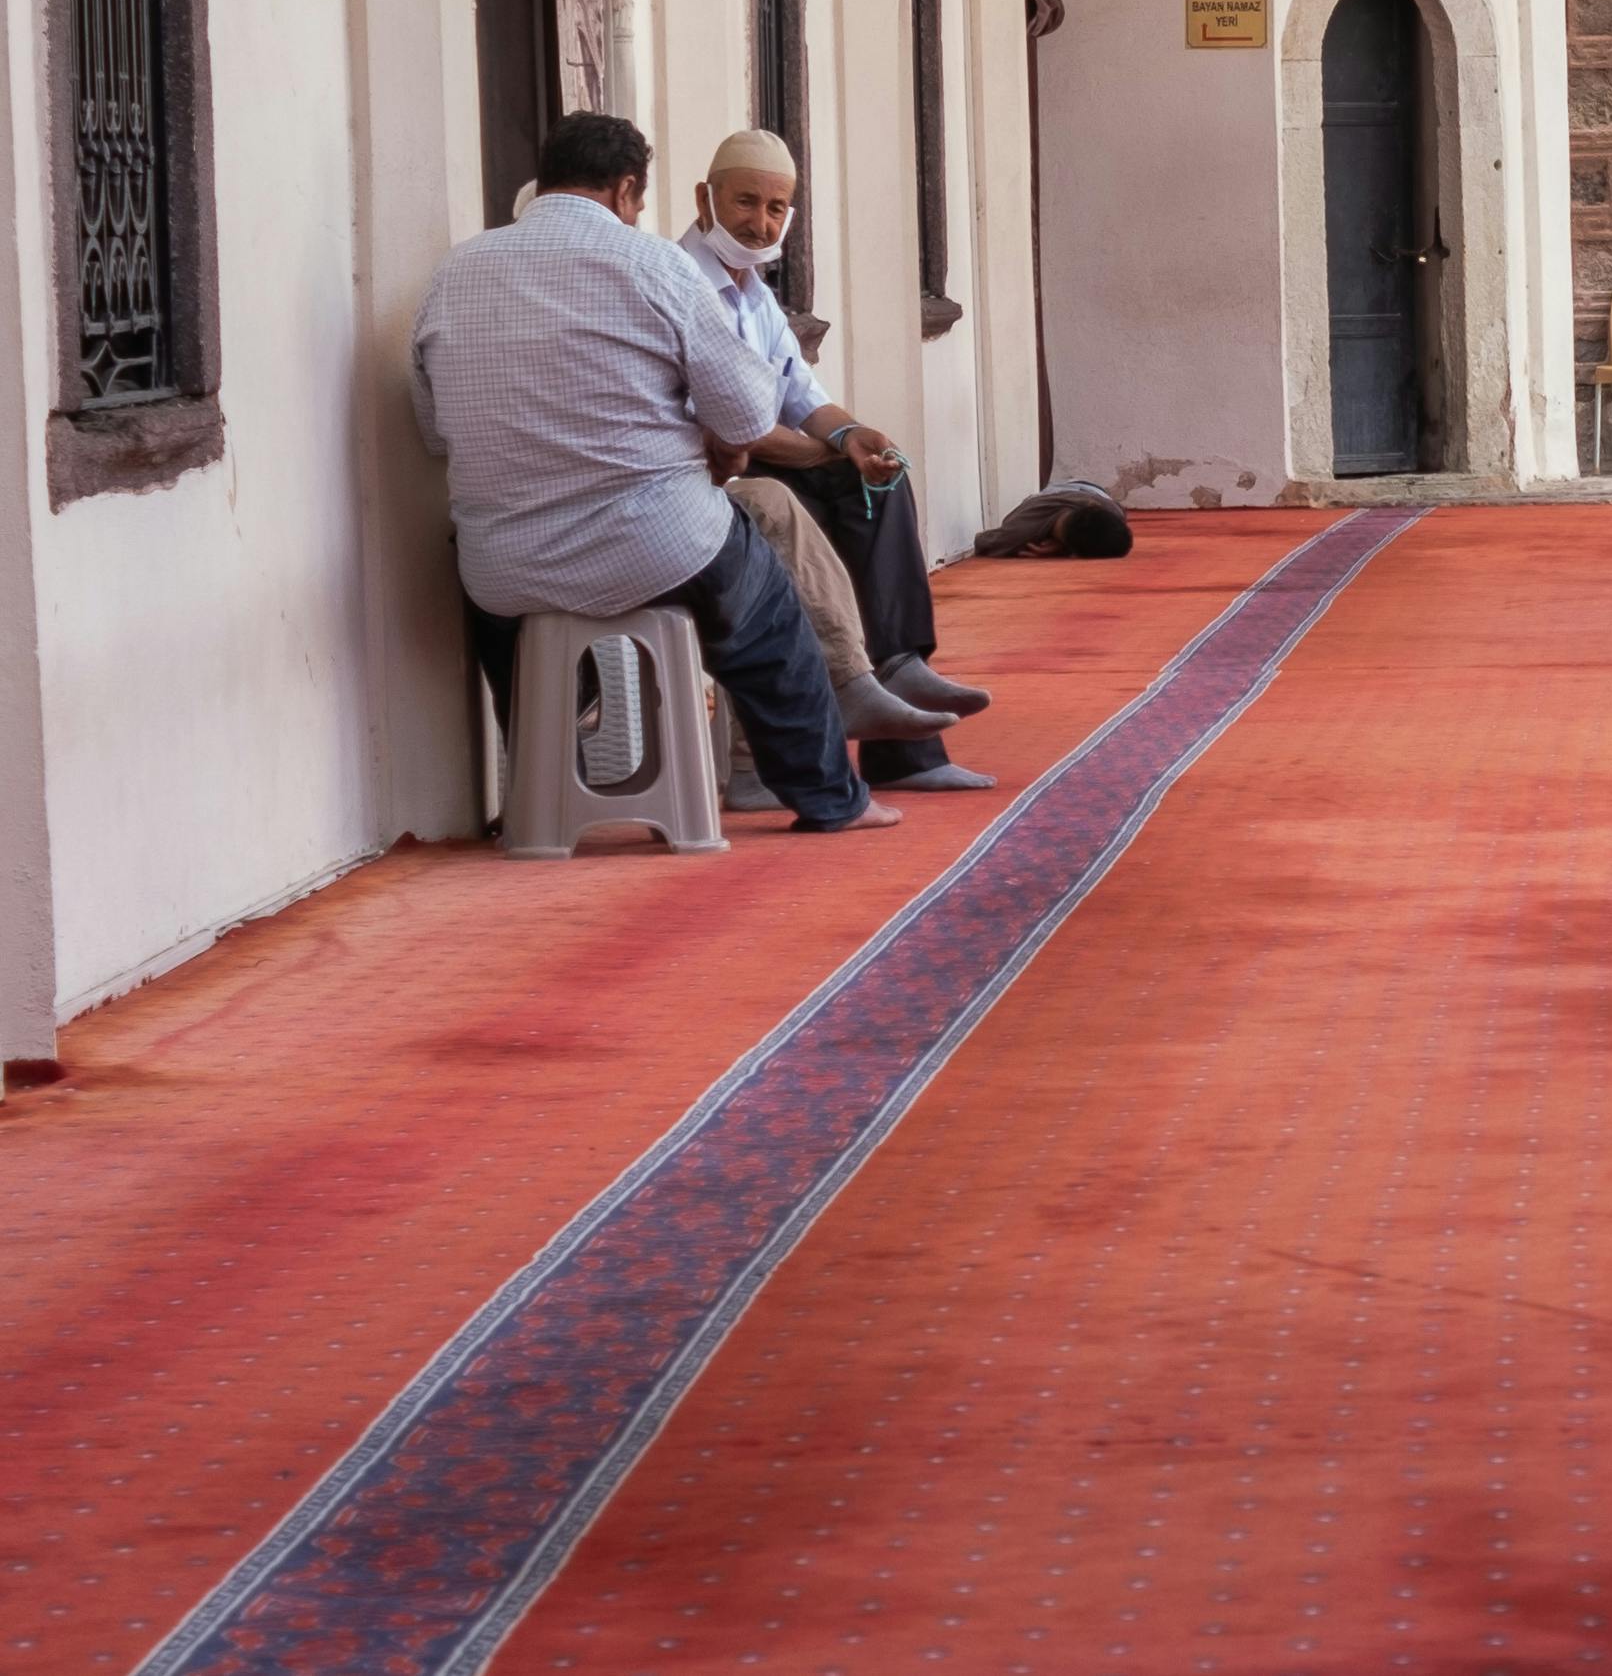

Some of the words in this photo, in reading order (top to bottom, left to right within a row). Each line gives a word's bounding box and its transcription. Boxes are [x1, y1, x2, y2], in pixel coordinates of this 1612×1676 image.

[1191, 0, 1225, 13] BAYAN
[1226, 0, 1262, 12] NAMAZ
[1215, 14, 1238, 27] YERİ
